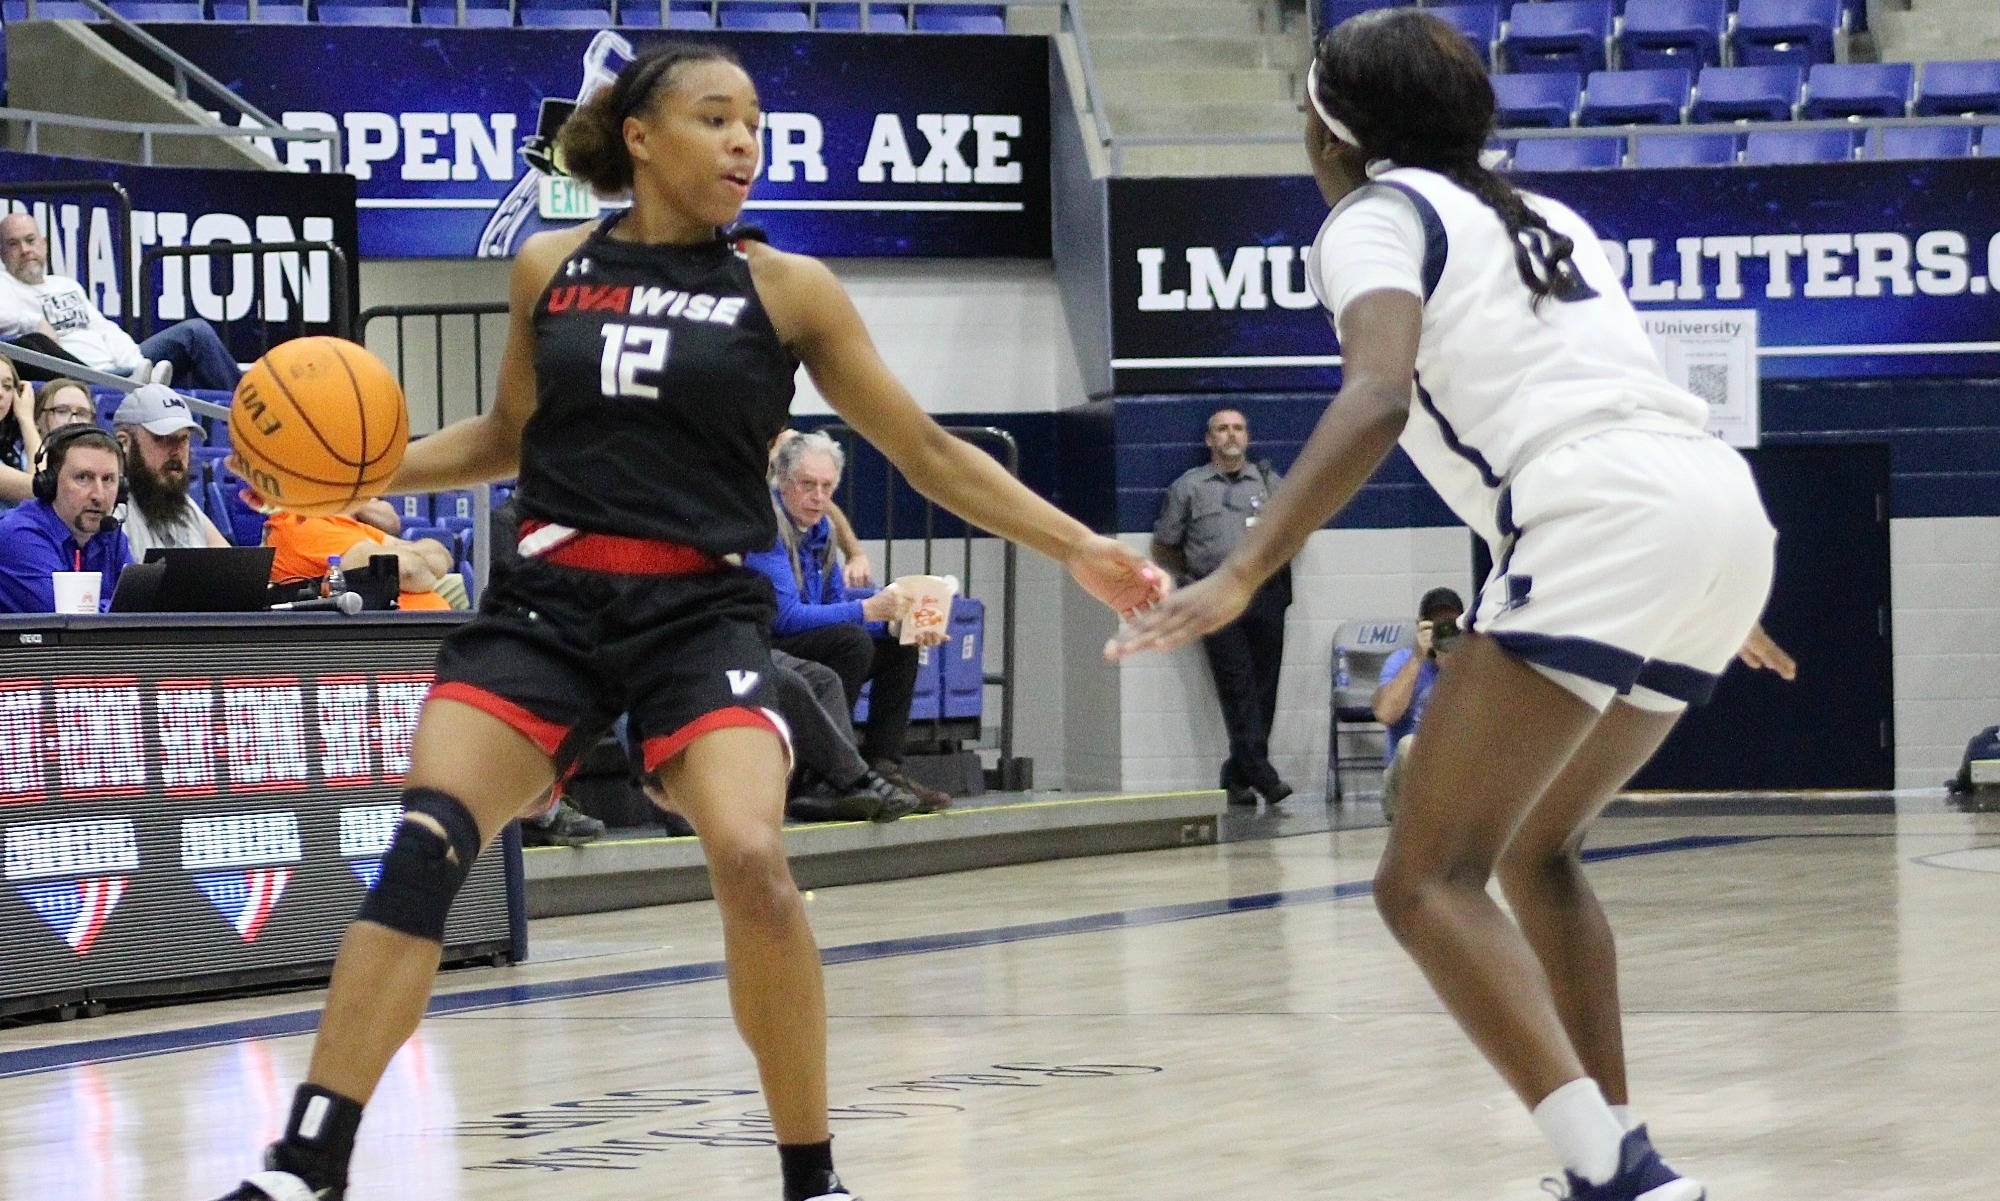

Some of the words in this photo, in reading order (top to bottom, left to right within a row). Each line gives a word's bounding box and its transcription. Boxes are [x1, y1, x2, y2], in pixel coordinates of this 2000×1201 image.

[858, 113, 1022, 183] AXE
[551, 180, 589, 213] EXIT
[0, 199, 334, 322] NATION
[1654, 320, 1741, 337] University
[600, 322, 669, 399] 12
[1356, 624, 1402, 645] LMU
